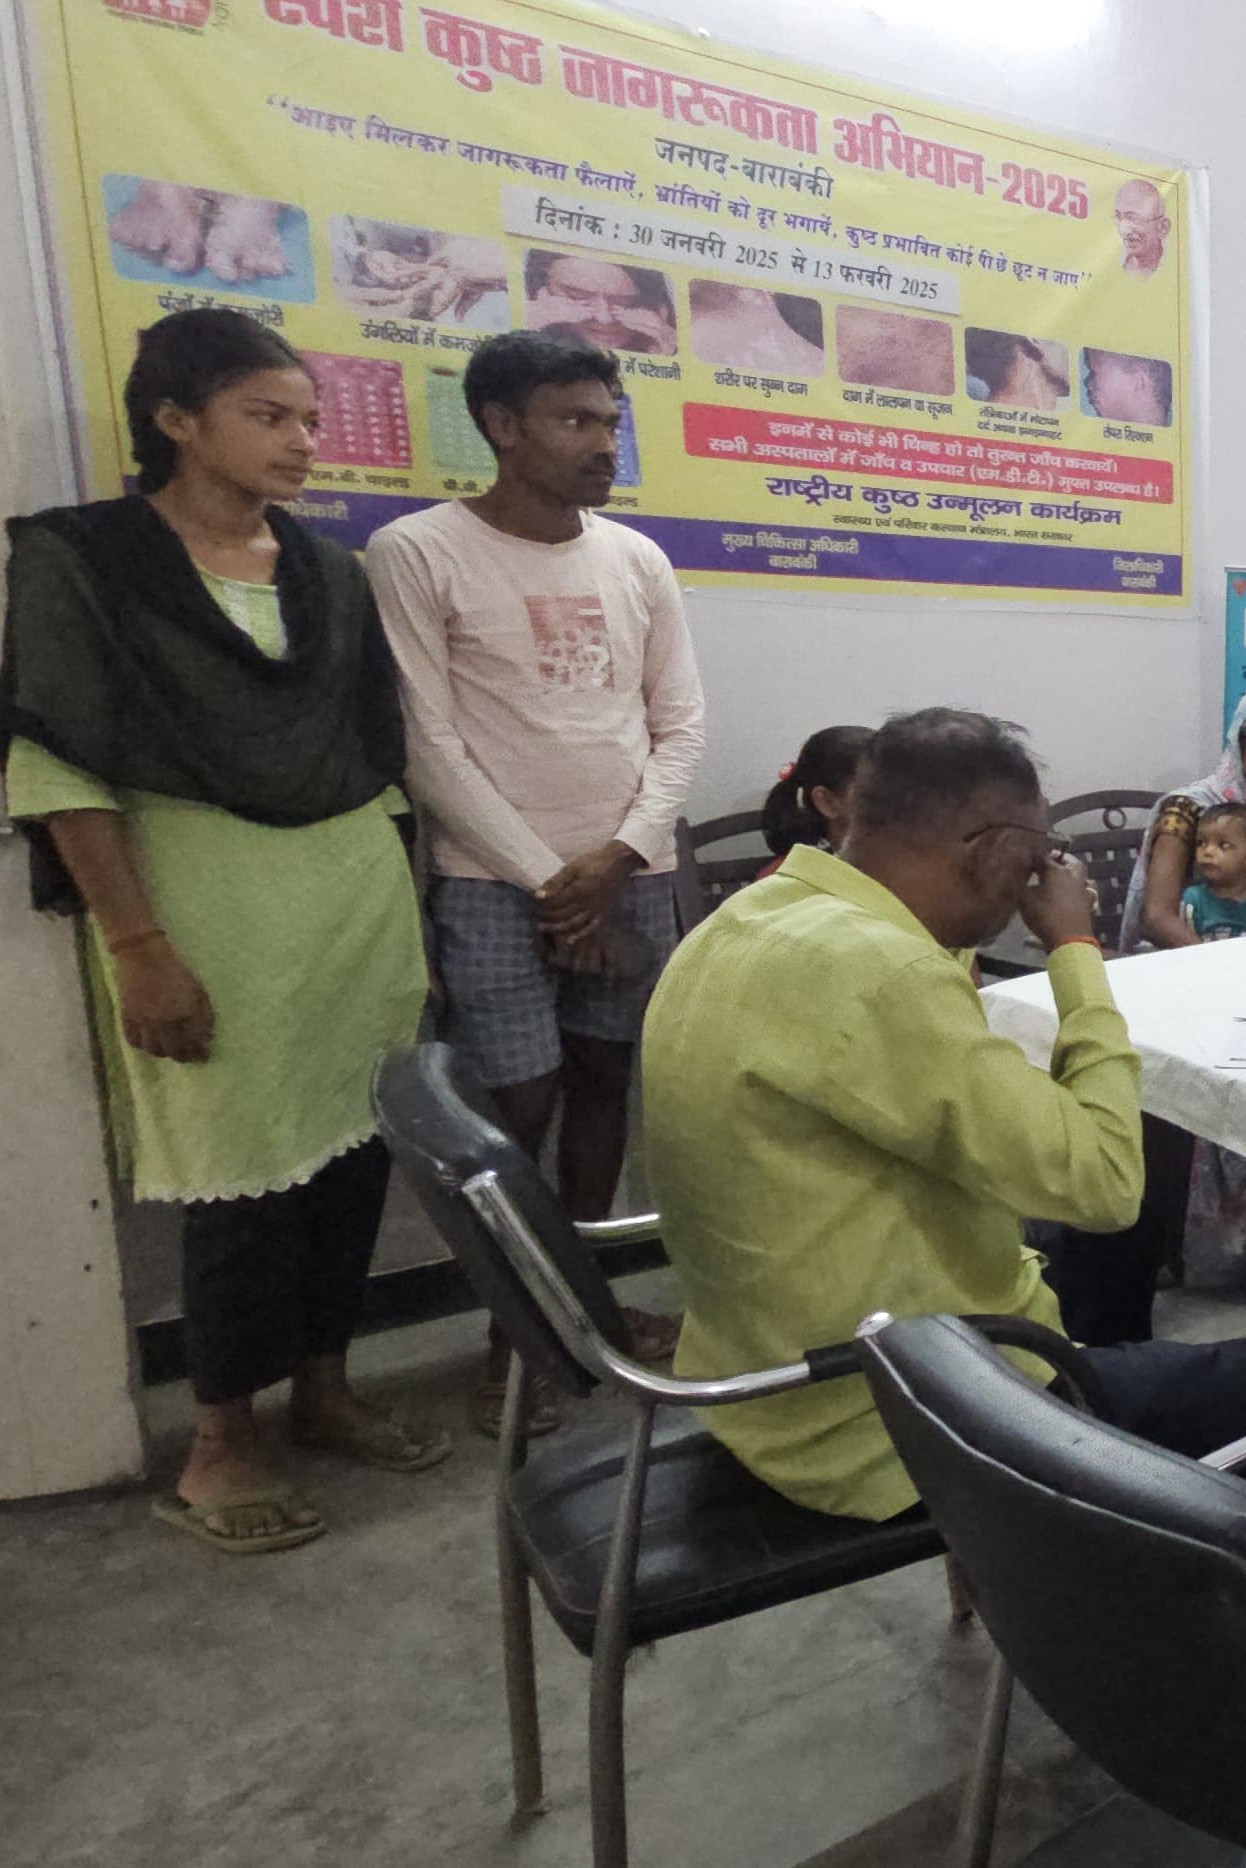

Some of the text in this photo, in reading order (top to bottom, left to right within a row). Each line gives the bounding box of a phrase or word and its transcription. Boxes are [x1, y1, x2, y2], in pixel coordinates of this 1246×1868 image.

[558, 45, 819, 155] जागरूकता
[834, 113, 1089, 220] अभियान-2025
[654, 137, 834, 199] जनपद-बाराबंकी
[364, 114, 450, 156] मिलकर
[457, 141, 568, 182] जागरूकता
[656, 181, 722, 213] भ्रांतियों
[728, 196, 750, 219] को
[757, 207, 777, 231] दूर
[883, 233, 941, 259] प्रभावित
[946, 244, 974, 268] कोई
[1037, 264, 1047, 281] न
[535, 196, 939, 300] दिनांक 30 जनवरी 2025 से 13 फरवरी 2025
[714, 368, 740, 387] शरीर
[743, 376, 758, 390] पर
[708, 435, 748, 453] सभी
[753, 442, 835, 464] अस्पतालों
[839, 449, 856, 466] में
[901, 459, 913, 471] व
[916, 461, 965, 478] उपचार
[768, 421, 814, 438] इनमें
[816, 425, 834, 441] से
[838, 429, 875, 448] कोई
[878, 431, 899, 450] भी
[945, 439, 963, 457] हो
[966, 443, 984, 459] तो
[765, 474, 1123, 526] राष्ट्रीय कुष्ठ उन्मूलन कार्यक्रम
[721, 531, 859, 554] मुख्य चिकित्सा अधिकारी
[894, 517, 928, 531] परिवार
